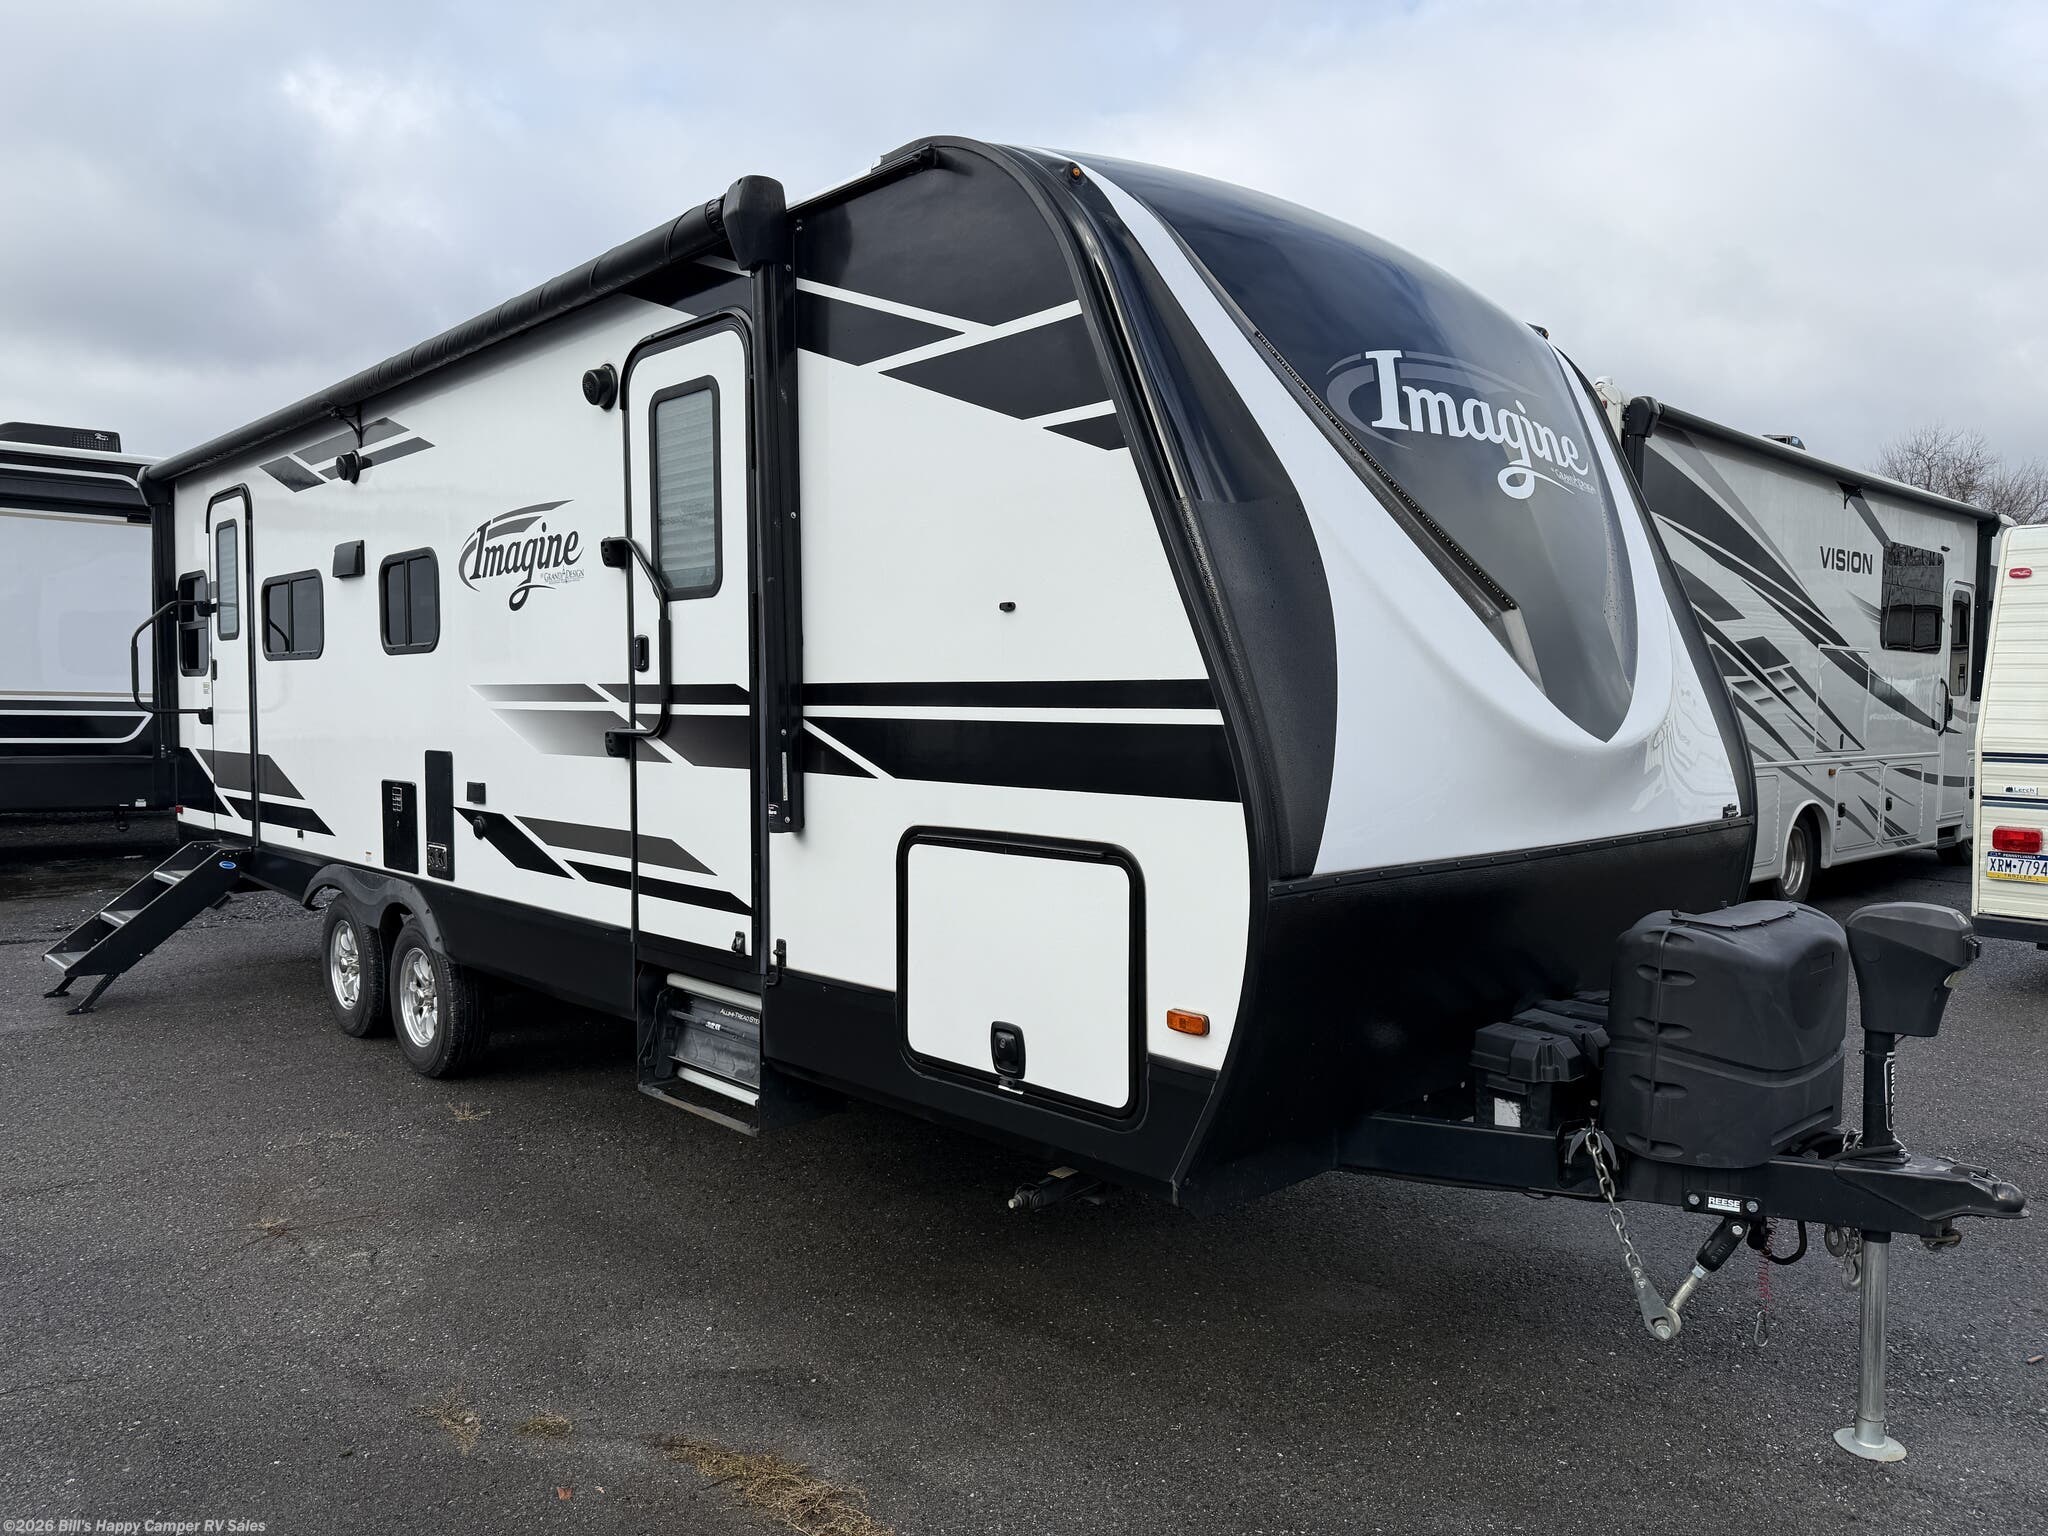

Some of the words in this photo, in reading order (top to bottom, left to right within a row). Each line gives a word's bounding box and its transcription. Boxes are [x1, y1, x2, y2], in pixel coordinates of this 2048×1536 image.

[1364, 349, 1589, 500] Imagine
[468, 519, 584, 611] Imagine
[1820, 546, 1873, 575] VISION
[1708, 1196, 1741, 1208] REESE
